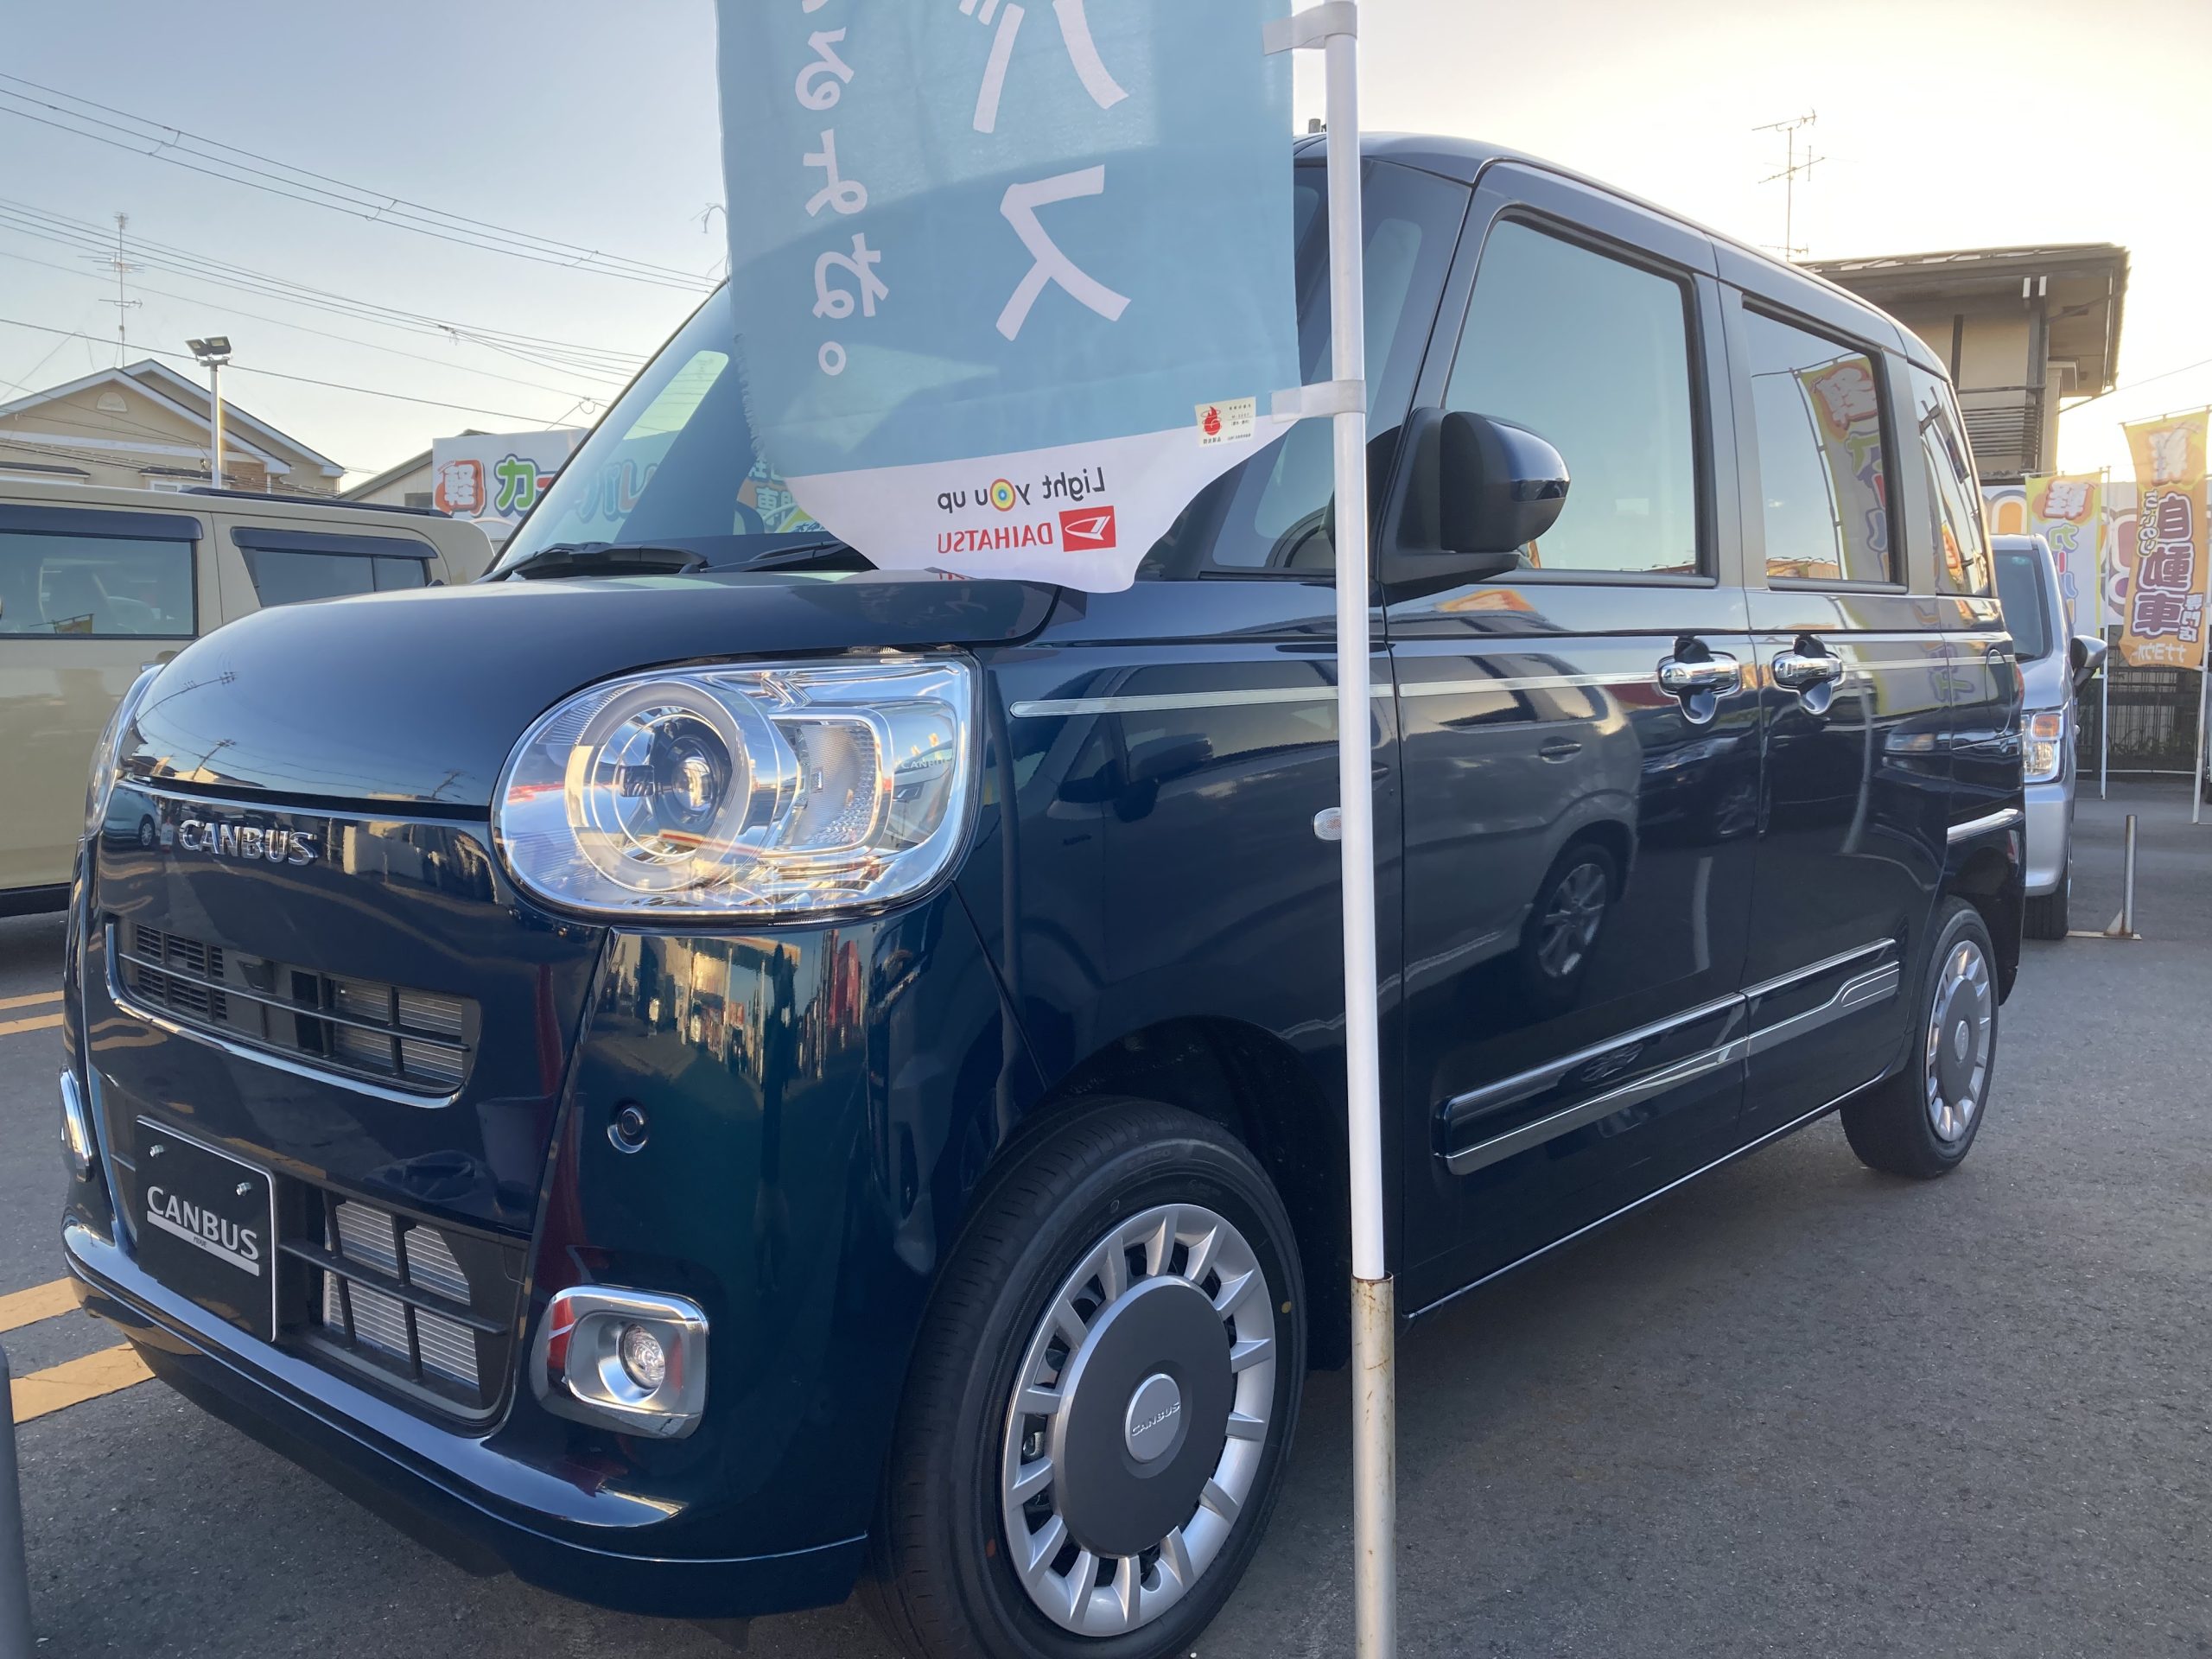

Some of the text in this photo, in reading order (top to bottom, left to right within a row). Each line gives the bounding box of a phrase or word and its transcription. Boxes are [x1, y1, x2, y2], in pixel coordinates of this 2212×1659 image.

[178, 819, 319, 867] CANBUS
[146, 1185, 259, 1261] CANBUS
[1131, 1402, 1181, 1437] CANBUS
